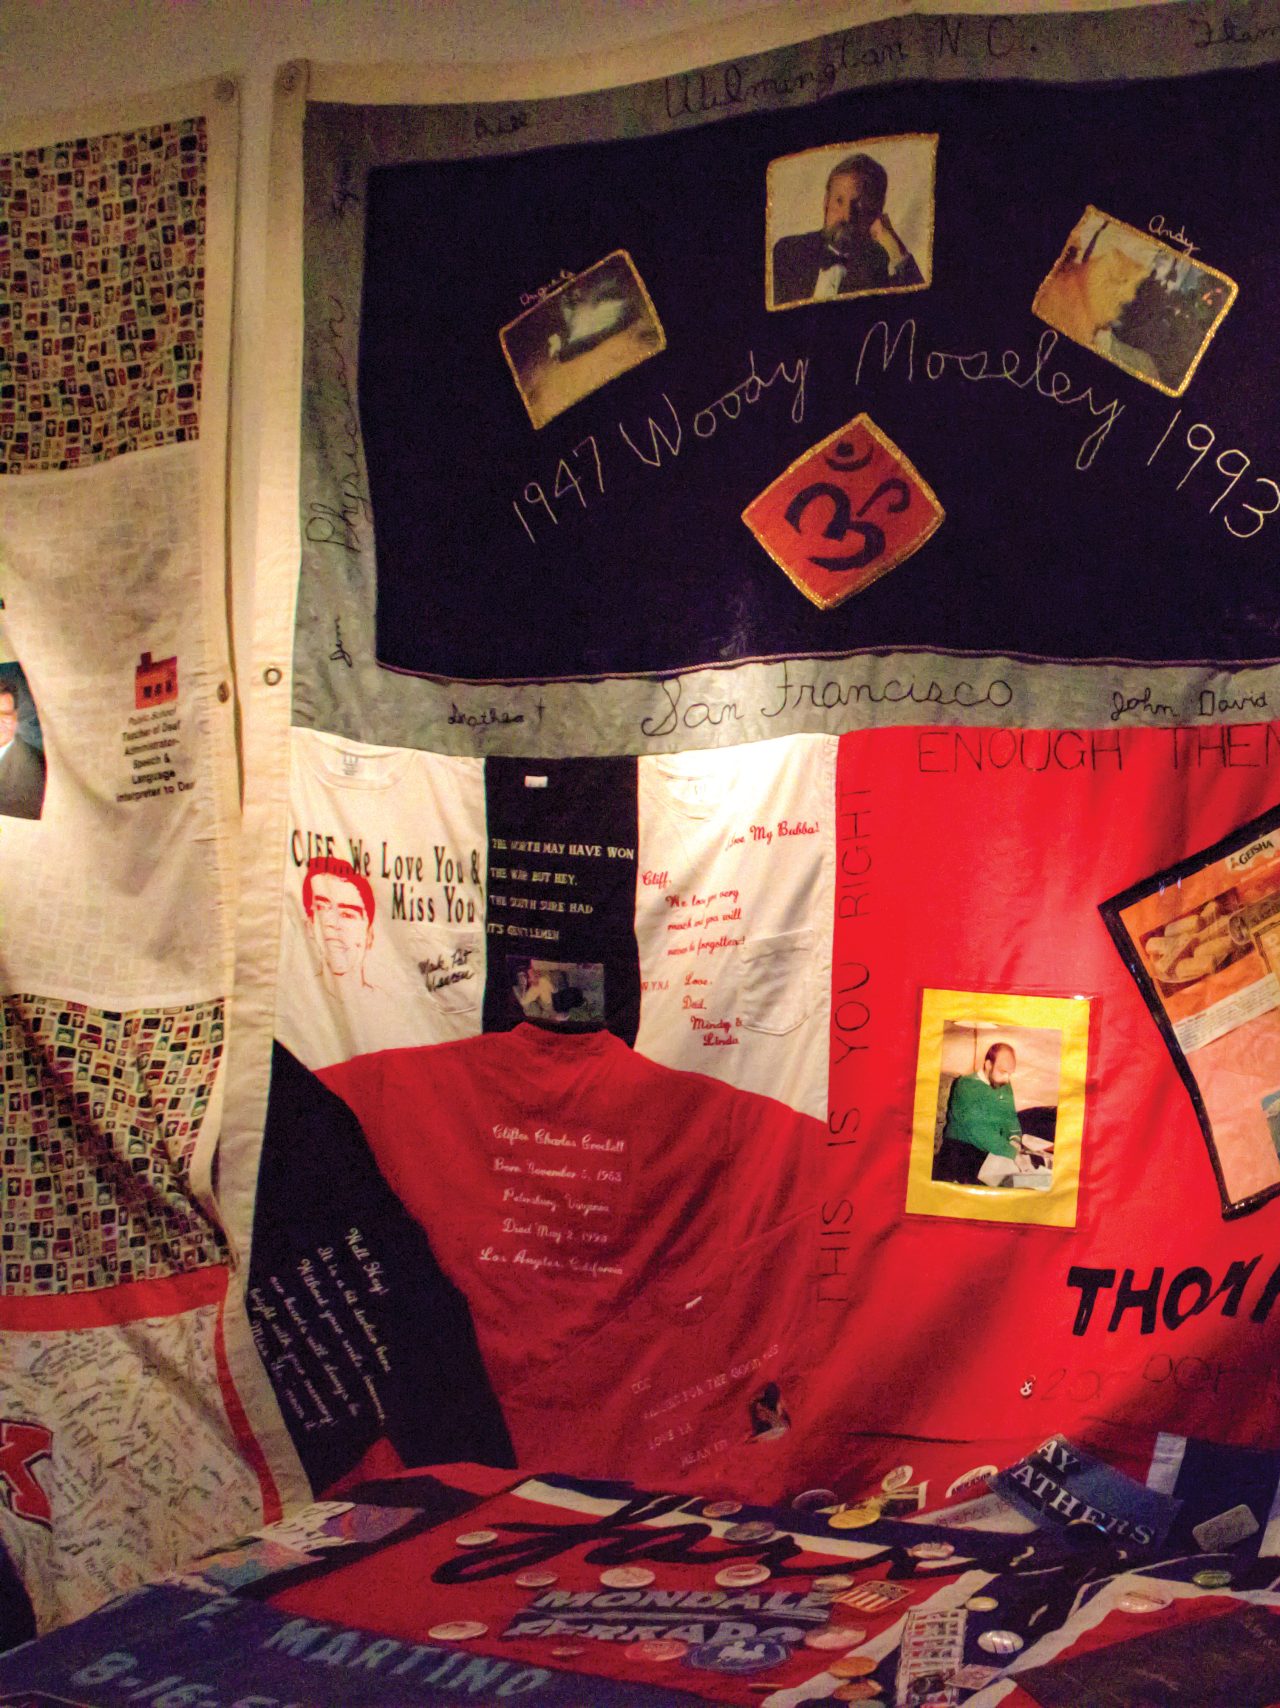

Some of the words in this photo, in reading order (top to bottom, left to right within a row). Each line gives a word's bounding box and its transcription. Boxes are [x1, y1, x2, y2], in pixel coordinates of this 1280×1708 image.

[512, 436, 606, 543] 1947
[618, 351, 810, 467] Woody
[856, 319, 1126, 471] Moseley
[641, 676, 745, 737] San
[760, 660, 1014, 717] Francisco
[1110, 687, 1179, 721] John
[1198, 689, 1268, 716] David
[919, 729, 1122, 772] ENOUGH
[132, 770, 176, 785] Language
[750, 825, 773, 845] My
[777, 820, 820, 836] Bubba!
[381, 841, 423, 881] Love
[434, 846, 464, 884] You
[471, 850, 481, 885] &
[543, 842, 565, 855] MAY
[569, 844, 602, 857] HAVE
[607, 846, 634, 860] WON
[836, 782, 872, 917] RIGHT
[1238, 839, 1275, 867] GEISHA
[490, 867, 507, 879] THE
[531, 870, 551, 883] BUT
[392, 883, 434, 922] Miss
[444, 886, 475, 922] You
[490, 895, 507, 906] THE
[540, 900, 565, 912] SURE
[569, 902, 593, 914] HAD
[720, 890, 739, 904] very
[722, 908, 741, 921] will
[690, 1016, 732, 1034] Mindy
[833, 961, 870, 1065] YOU
[703, 1032, 739, 1047] Linda
[826, 1107, 861, 1146] IS
[494, 1157, 522, 1172] Born
[526, 1158, 576, 1179] November
[535, 1222, 562, 1244] May
[480, 1246, 507, 1262] Los
[817, 1198, 854, 1310] THIS
[1034, 1438, 1080, 1477] AY
[1011, 1463, 1158, 1546] ATHERS
[530, 1590, 836, 1612] MONDALE
[259, 1616, 554, 1697] MARTINO
